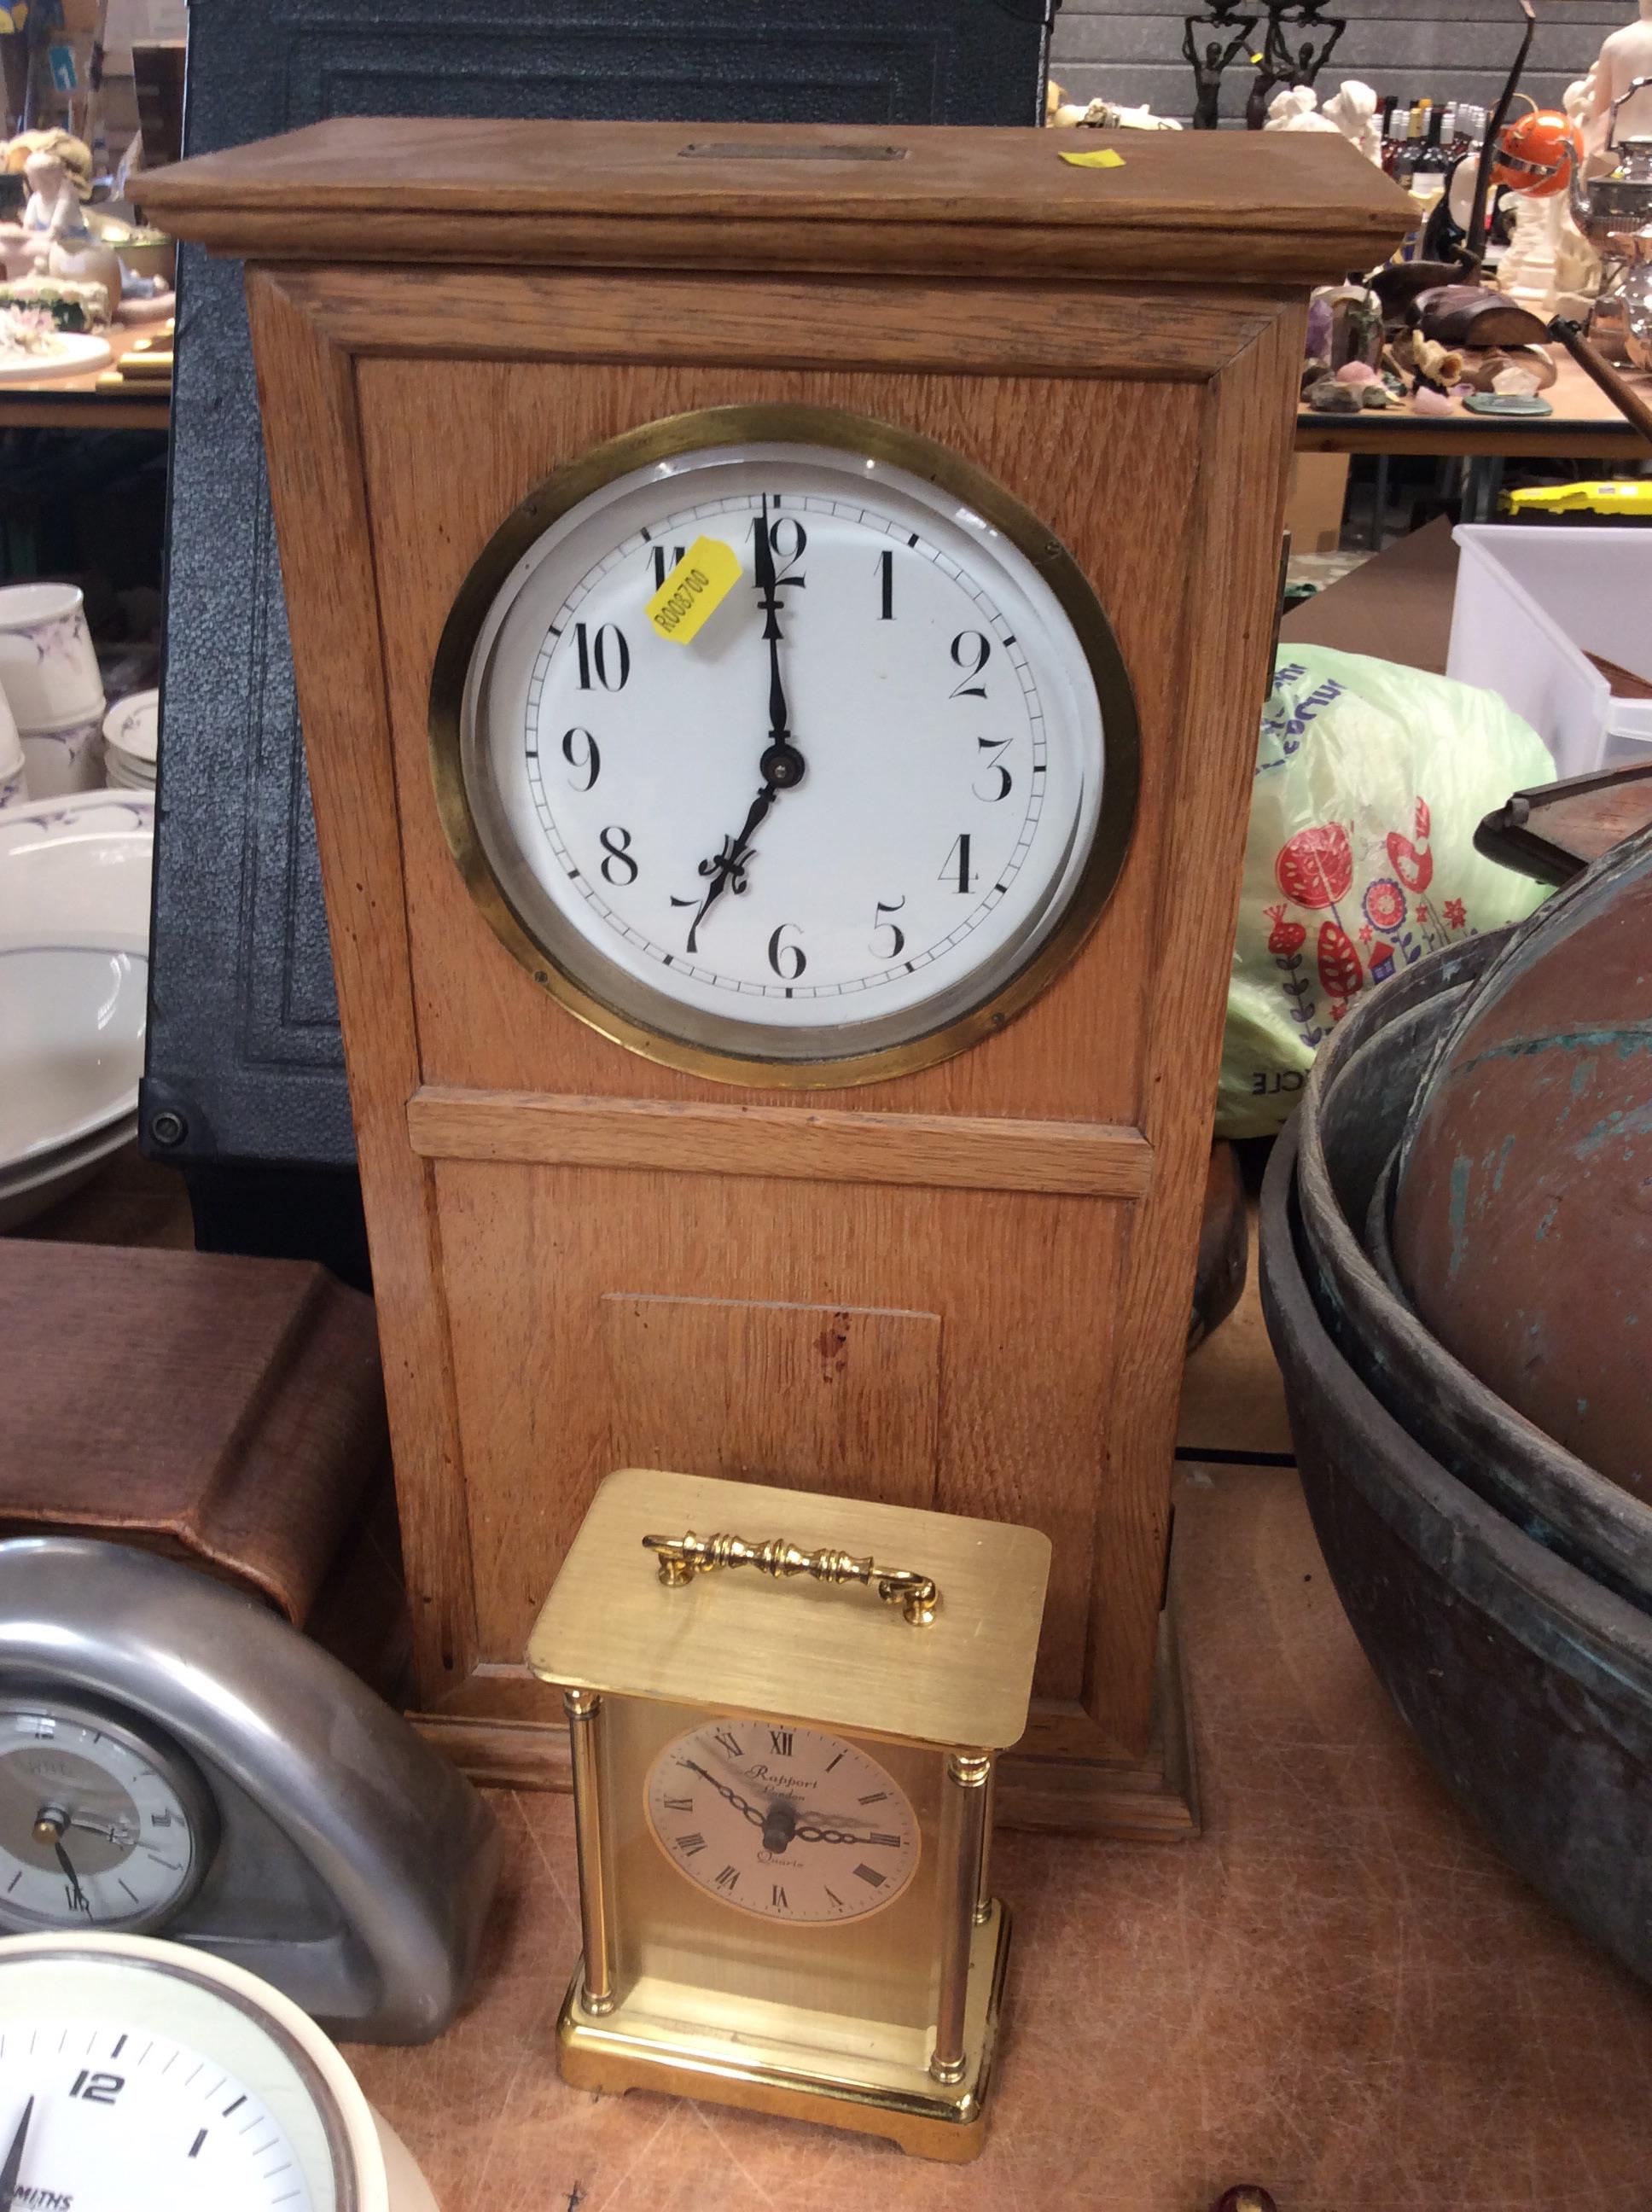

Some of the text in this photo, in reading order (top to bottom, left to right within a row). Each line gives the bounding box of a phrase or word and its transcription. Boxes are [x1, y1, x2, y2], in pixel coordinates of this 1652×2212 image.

[745, 517, 807, 589] 12
[872, 550, 896, 621] 1
[569, 622, 630, 692] 10
[949, 631, 991, 699] 2
[562, 728, 601, 793] 9
[972, 737, 1014, 802] 3
[599, 826, 638, 887] 8
[937, 834, 979, 894] 4
[671, 895, 702, 953] 7
[768, 923, 806, 980] 6
[866, 894, 906, 959] 5
[770, 1731, 793, 1756] XII
[744, 1764, 817, 1789] Rapport
[772, 1884, 788, 1908] VI
[69, 2069, 125, 2106] 12
[187, 2128, 209, 2158] 1
[14, 2186, 73, 2212] MITHS
